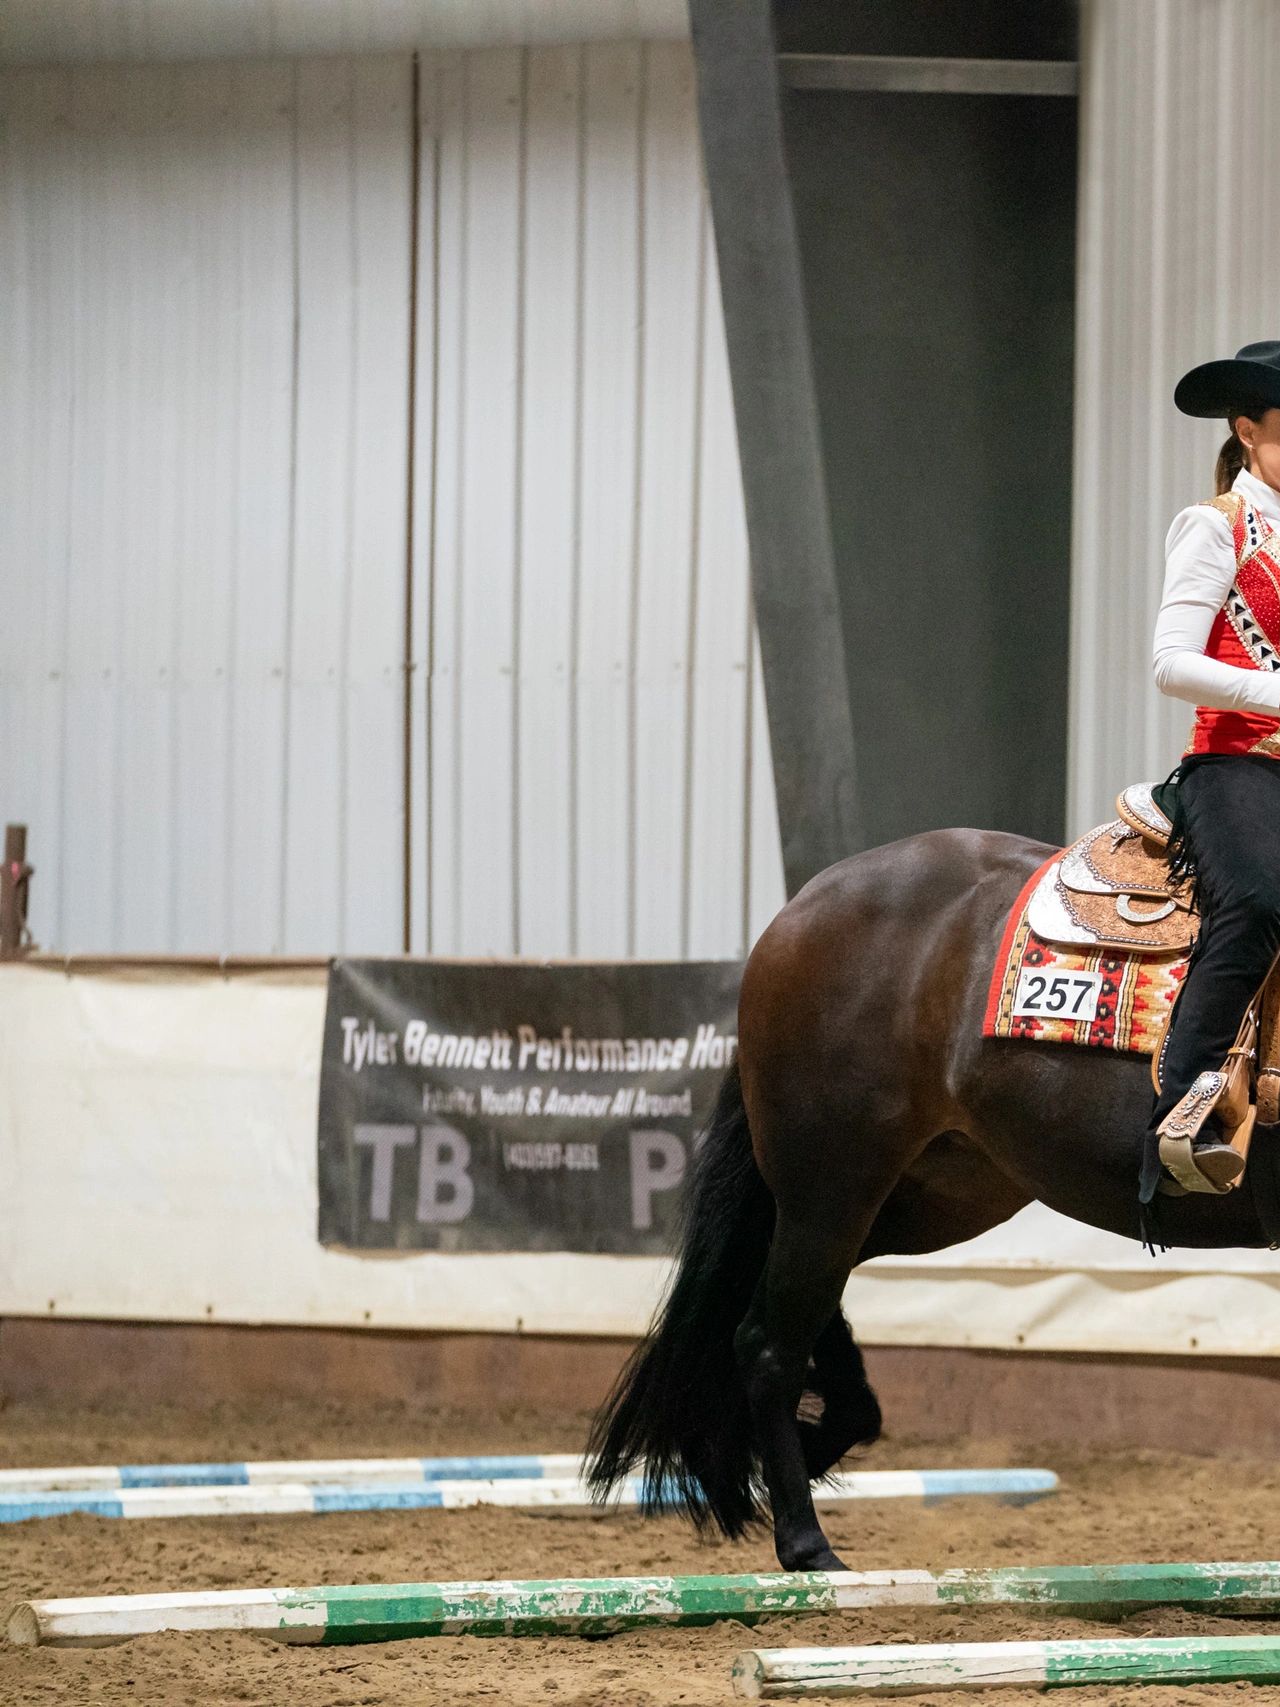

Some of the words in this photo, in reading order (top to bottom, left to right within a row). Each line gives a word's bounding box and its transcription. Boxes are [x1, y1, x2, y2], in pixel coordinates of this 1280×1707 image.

[1022, 976, 1094, 1013] 257
[340, 1016, 398, 1072] Tyler
[404, 1019, 513, 1070] Bennett
[517, 1023, 690, 1072] Performance
[689, 1023, 738, 1069] Hor
[525, 1086, 543, 1116] &
[543, 1087, 613, 1117] Amateur
[353, 1123, 475, 1224] TB
[629, 1129, 708, 1229] P
